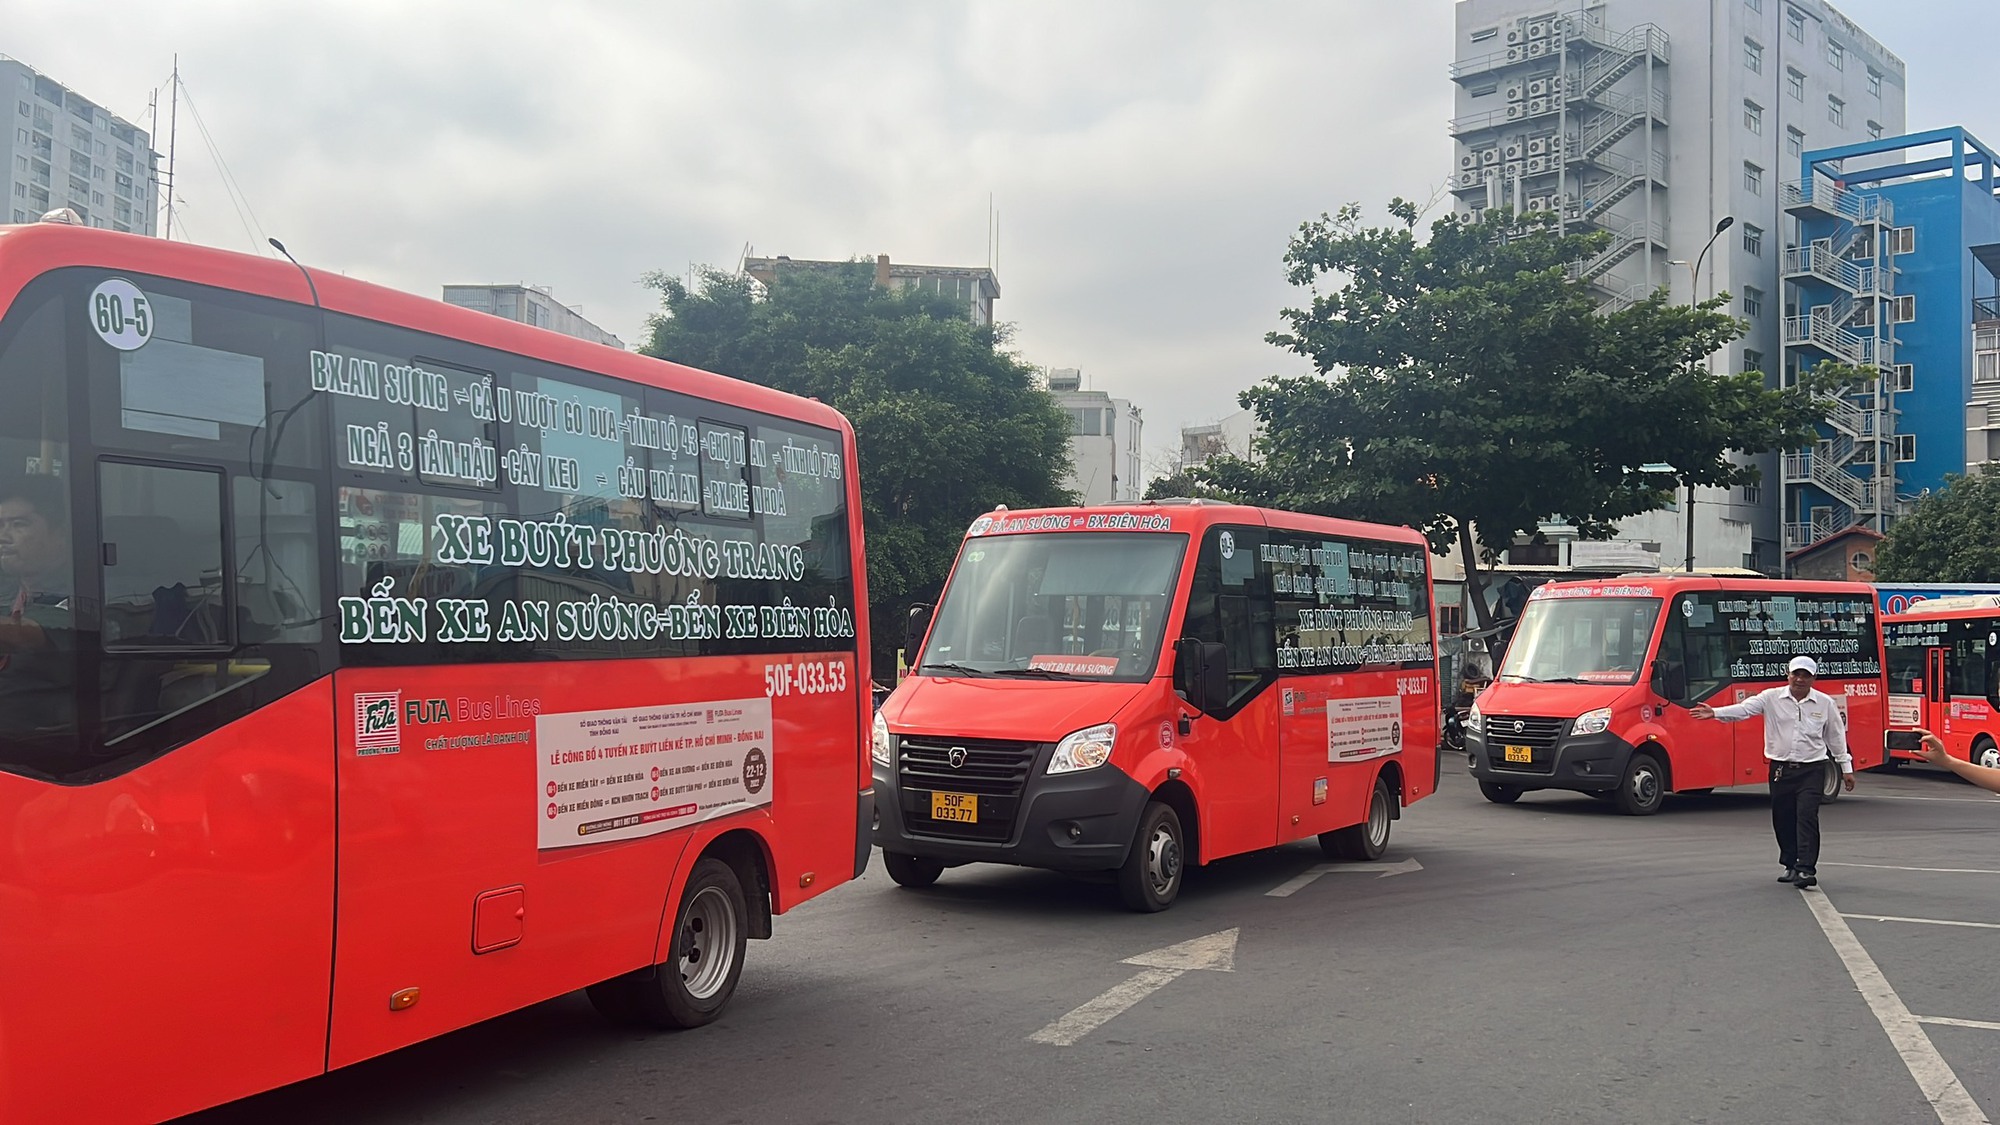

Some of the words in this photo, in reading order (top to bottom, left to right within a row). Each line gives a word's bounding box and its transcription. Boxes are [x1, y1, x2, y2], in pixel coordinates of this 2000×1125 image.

[95, 292, 147, 337] 60-5
[311, 350, 379, 400] BX.AN
[384, 364, 448, 412] SƯƠNG
[516, 390, 558, 438] VƯỢT
[627, 407, 658, 450] TỈNH
[660, 416, 678, 460] LỘ
[681, 425, 699, 456] 43
[708, 430, 730, 468] CHỢ
[750, 439, 766, 467] AN
[783, 438, 806, 473] TỈNH
[807, 444, 821, 483] LỘ
[822, 453, 841, 479] 743
[347, 422, 393, 468] NGÃ
[398, 432, 412, 470] 3
[418, 430, 455, 476] TÂN
[459, 438, 496, 486] HẬU
[507, 444, 540, 486] CÂY
[547, 455, 580, 491] KEO
[681, 474, 699, 504] AN
[1027, 514, 1071, 530] SƯƠNG
[1087, 512, 1140, 528] BX.BIÊN
[436, 514, 494, 564] XE
[499, 512, 596, 569] BUÝT
[602, 525, 720, 579] PHƯƠNG
[724, 540, 804, 581] TRANG
[338, 576, 428, 644] BẾN
[436, 598, 490, 642] XE
[497, 599, 549, 642] AN
[557, 594, 659, 641] SƯƠNG
[669, 589, 720, 640] BẾN
[725, 605, 758, 639] XE
[760, 596, 810, 638] BIÊN
[1299, 609, 1314, 632] XE
[1344, 605, 1382, 631] PHƯƠNG
[1383, 611, 1413, 630] TRANG
[1301, 647, 1315, 667] XE
[1317, 646, 1331, 666] AN
[1332, 642, 1363, 665] SƯƠNG
[1386, 645, 1397, 662] XE
[1749, 640, 1764, 654] XE
[1791, 636, 1828, 654] PHƯƠNG
[1829, 639, 1859, 654] TRANG
[1076, 664, 1086, 672] AN
[1087, 663, 1114, 674] SƯƠNG
[1751, 663, 1764, 676] XE
[1766, 664, 1779, 676] AN
[1831, 662, 1842, 674] XE
[1843, 658, 1862, 674] BIÊN
[764, 661, 846, 697] 50F-033.53
[406, 699, 451, 725] FUTA
[457, 697, 492, 722] Bus
[496, 695, 541, 719] Lines
[493, 732, 516, 746] DANH
[586, 746, 596, 760] BỐ
[605, 743, 627, 758] TUYẾN
[630, 745, 638, 755] XE
[746, 764, 764, 778] 22-12
[944, 794, 964, 807] 50F
[936, 807, 972, 821] 033.77
